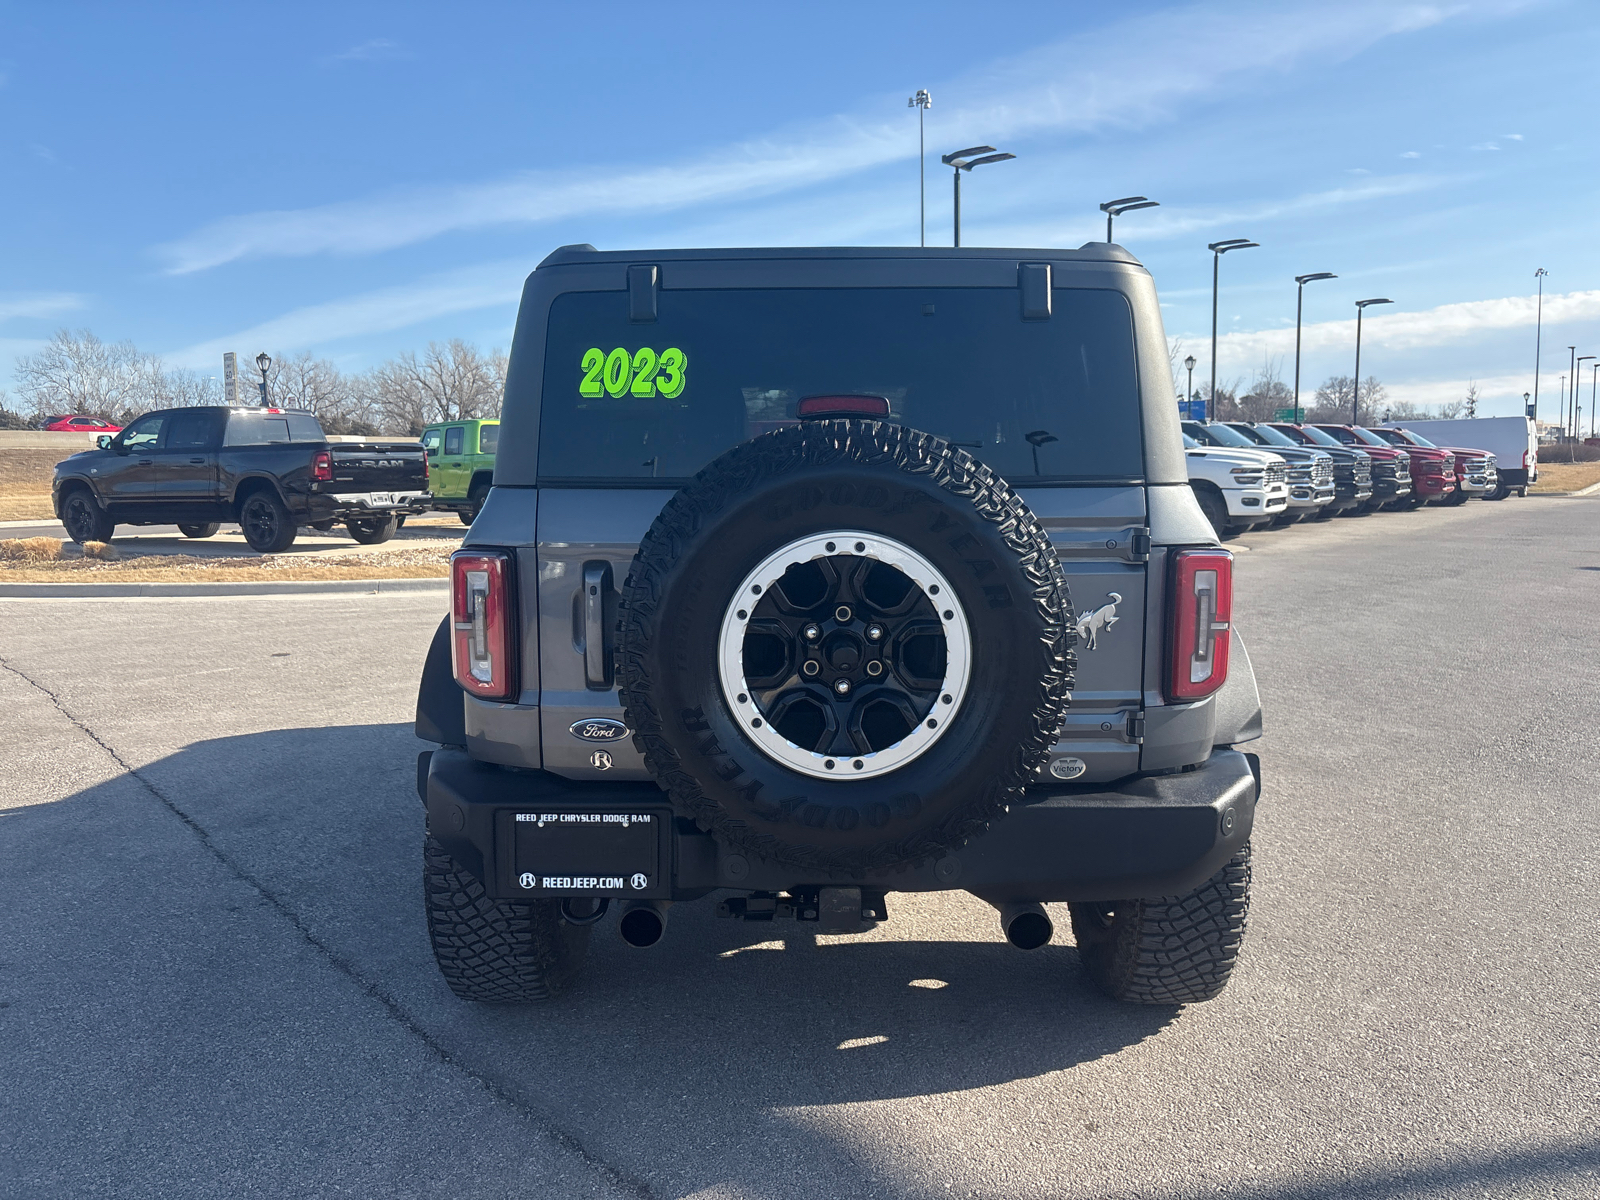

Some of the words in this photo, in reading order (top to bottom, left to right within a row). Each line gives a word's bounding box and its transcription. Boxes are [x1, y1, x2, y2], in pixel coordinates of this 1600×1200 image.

[579, 347, 688, 399] 2023
[361, 460, 404, 468] RAM
[583, 723, 616, 737] Ford
[515, 814, 537, 822] REED
[539, 814, 558, 822] JEEP
[560, 814, 601, 822] CHRYSLER
[603, 814, 629, 823] DODGE
[631, 814, 651, 823] RAM
[542, 877, 624, 889] REEDJEEP.COM
